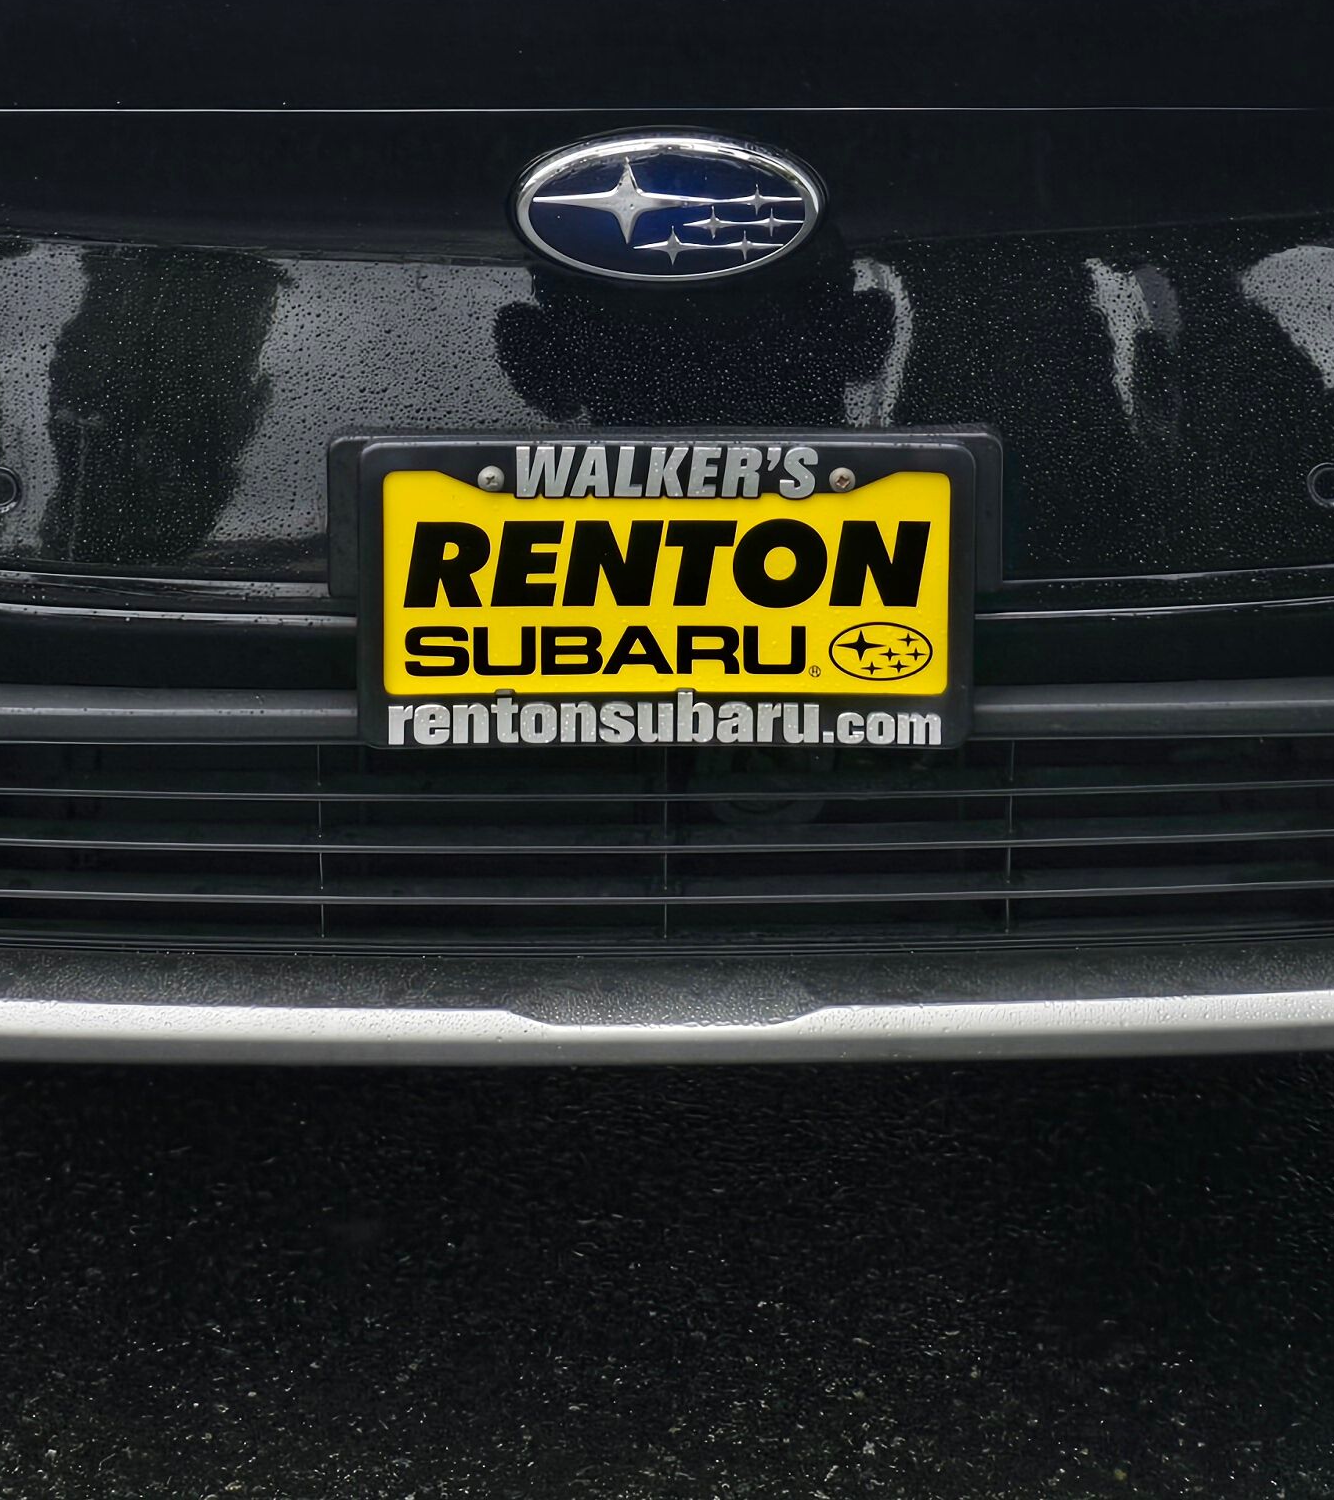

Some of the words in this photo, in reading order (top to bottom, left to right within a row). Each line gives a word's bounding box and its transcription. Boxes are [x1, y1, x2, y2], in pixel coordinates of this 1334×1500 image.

[514, 445, 820, 499] WALKER'S
[403, 518, 931, 609] RENTON
[404, 625, 807, 677] SUBARU
[387, 690, 942, 746] rentonsubaru.com
